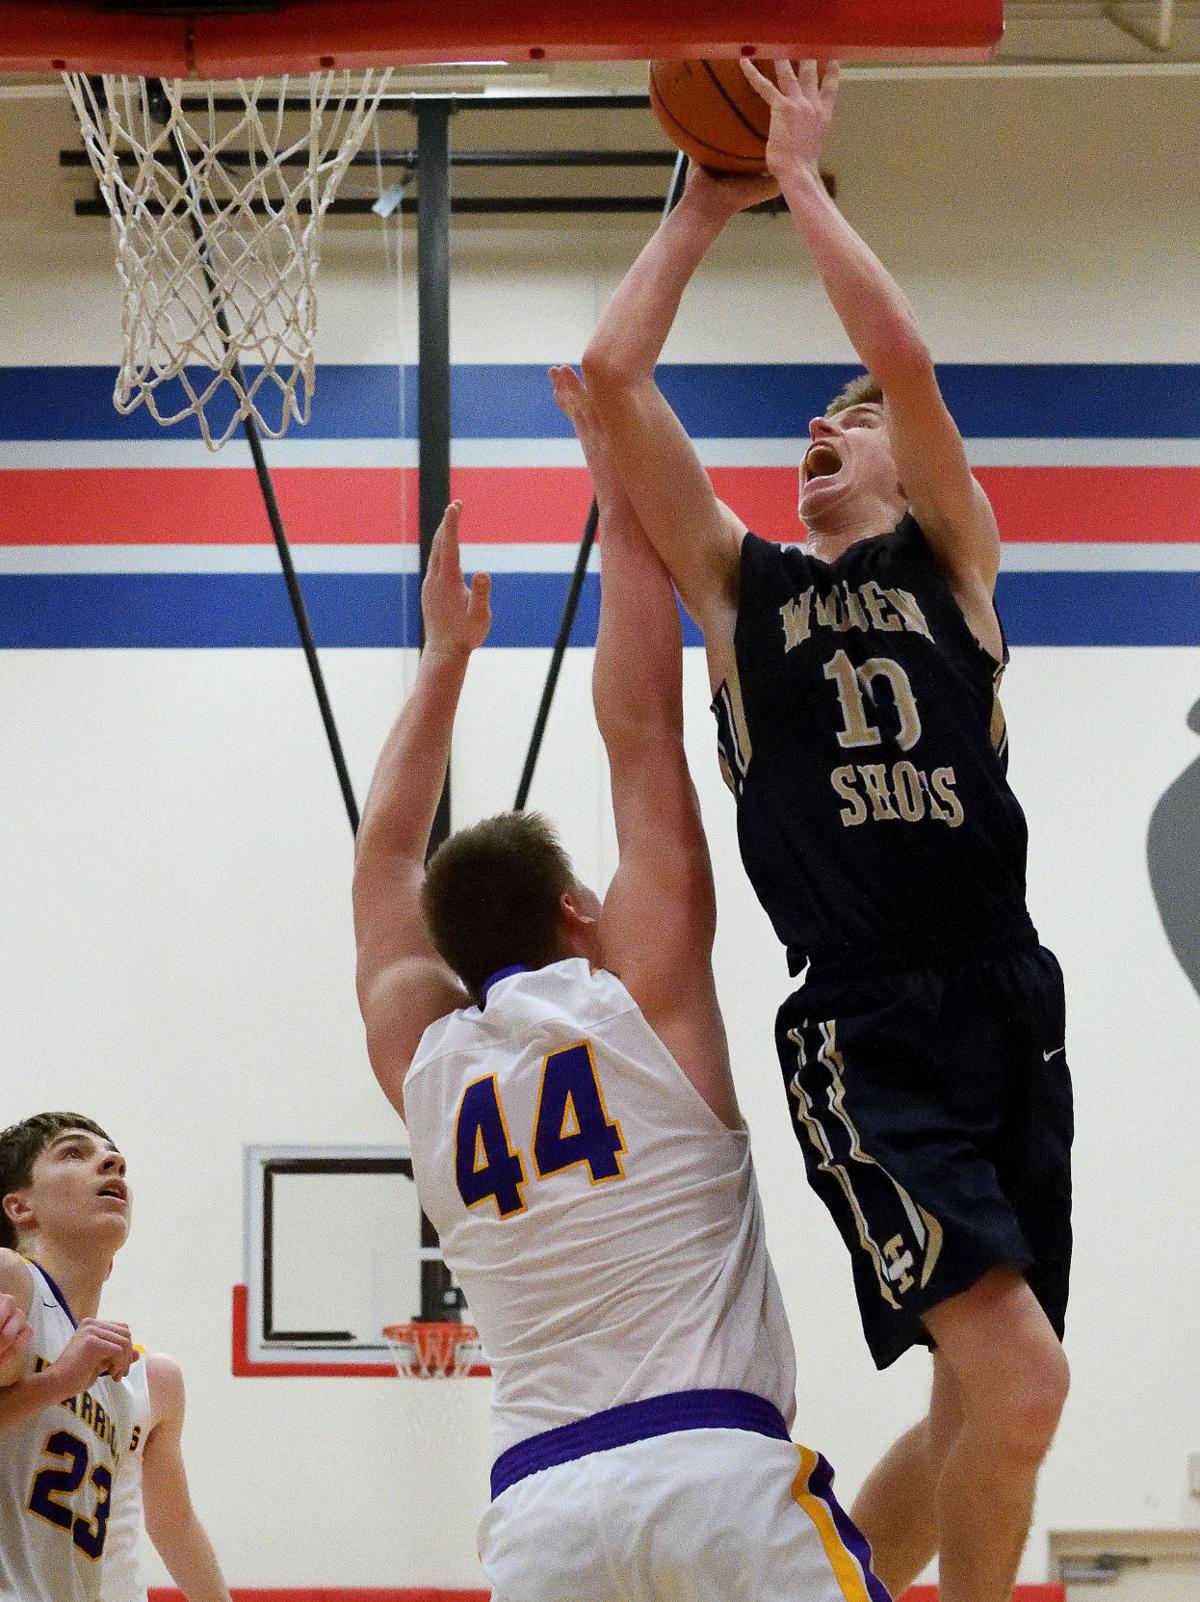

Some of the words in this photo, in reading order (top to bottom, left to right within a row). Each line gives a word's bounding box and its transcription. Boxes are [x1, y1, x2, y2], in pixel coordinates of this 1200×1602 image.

[779, 579, 936, 654] WOEN
[823, 649, 922, 752] 10
[453, 1038, 629, 1221] 44
[27, 1427, 112, 1563] 23
